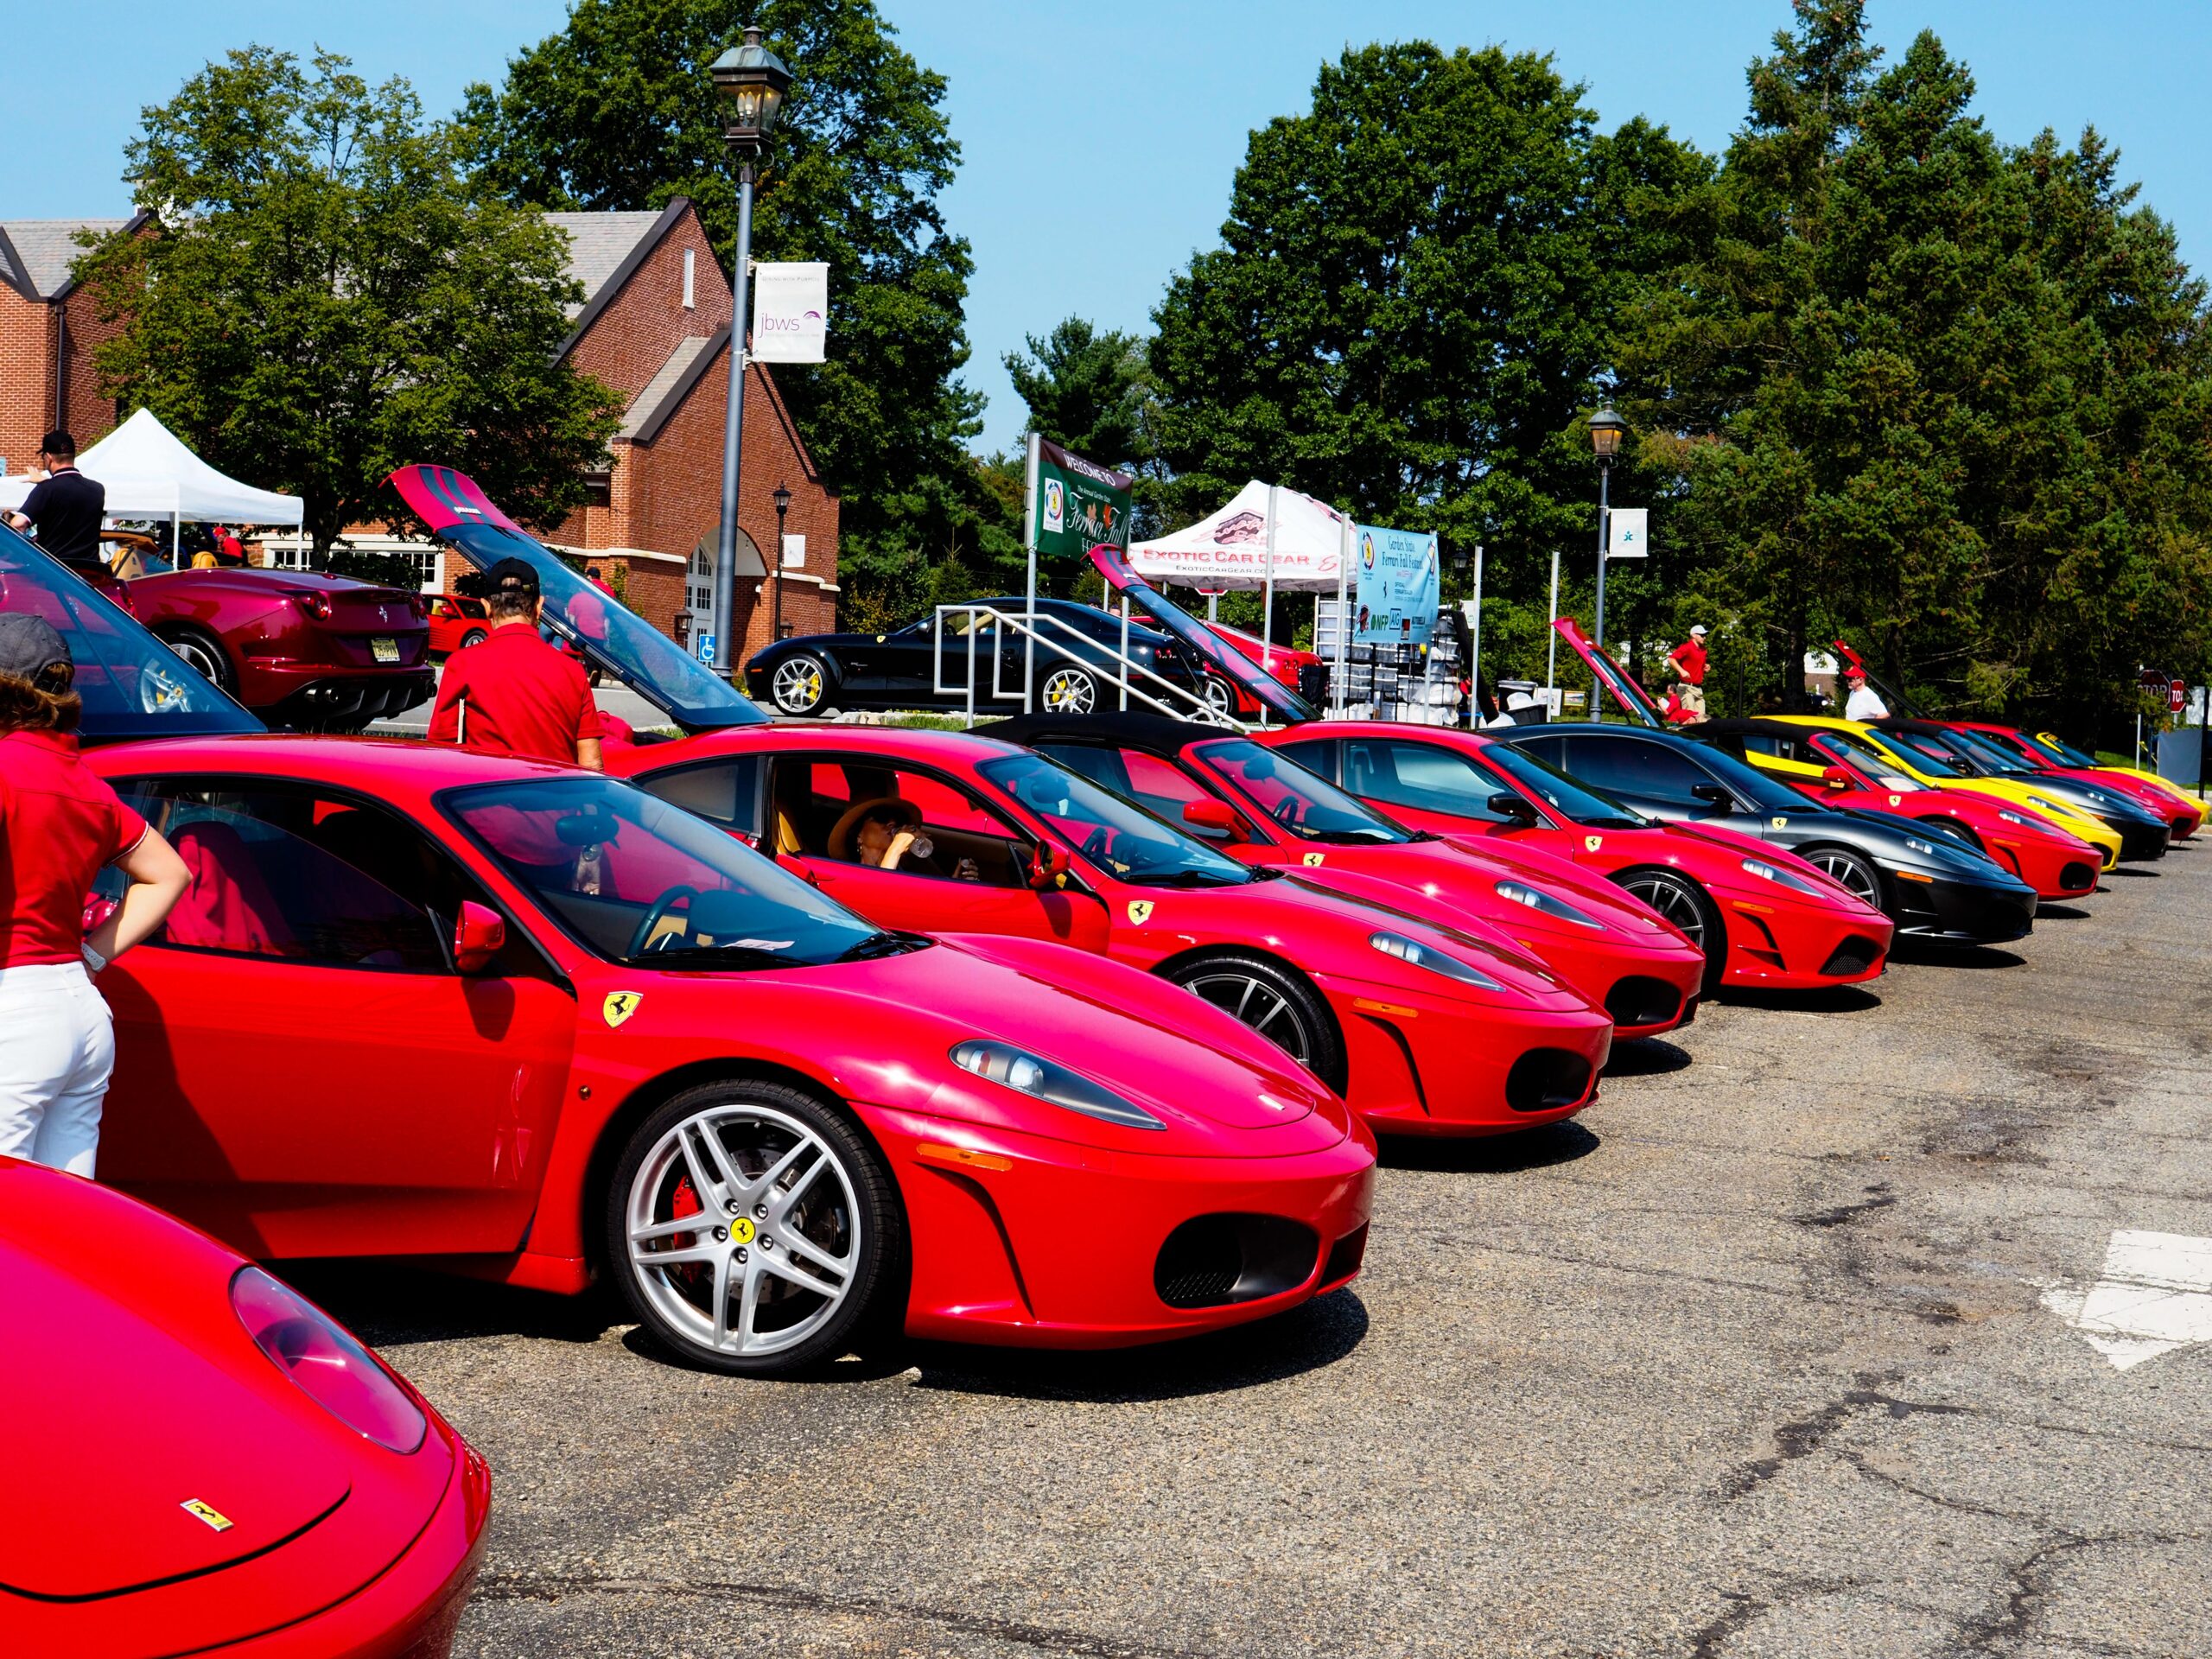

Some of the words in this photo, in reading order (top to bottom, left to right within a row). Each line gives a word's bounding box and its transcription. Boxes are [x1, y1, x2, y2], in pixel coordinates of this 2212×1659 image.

[759, 313, 800, 339] jbws
[1064, 453, 1104, 482] WELCOME
[1103, 472, 1116, 486] TO
[1104, 506, 1128, 547] Fall
[1376, 614, 1389, 631] NFP
